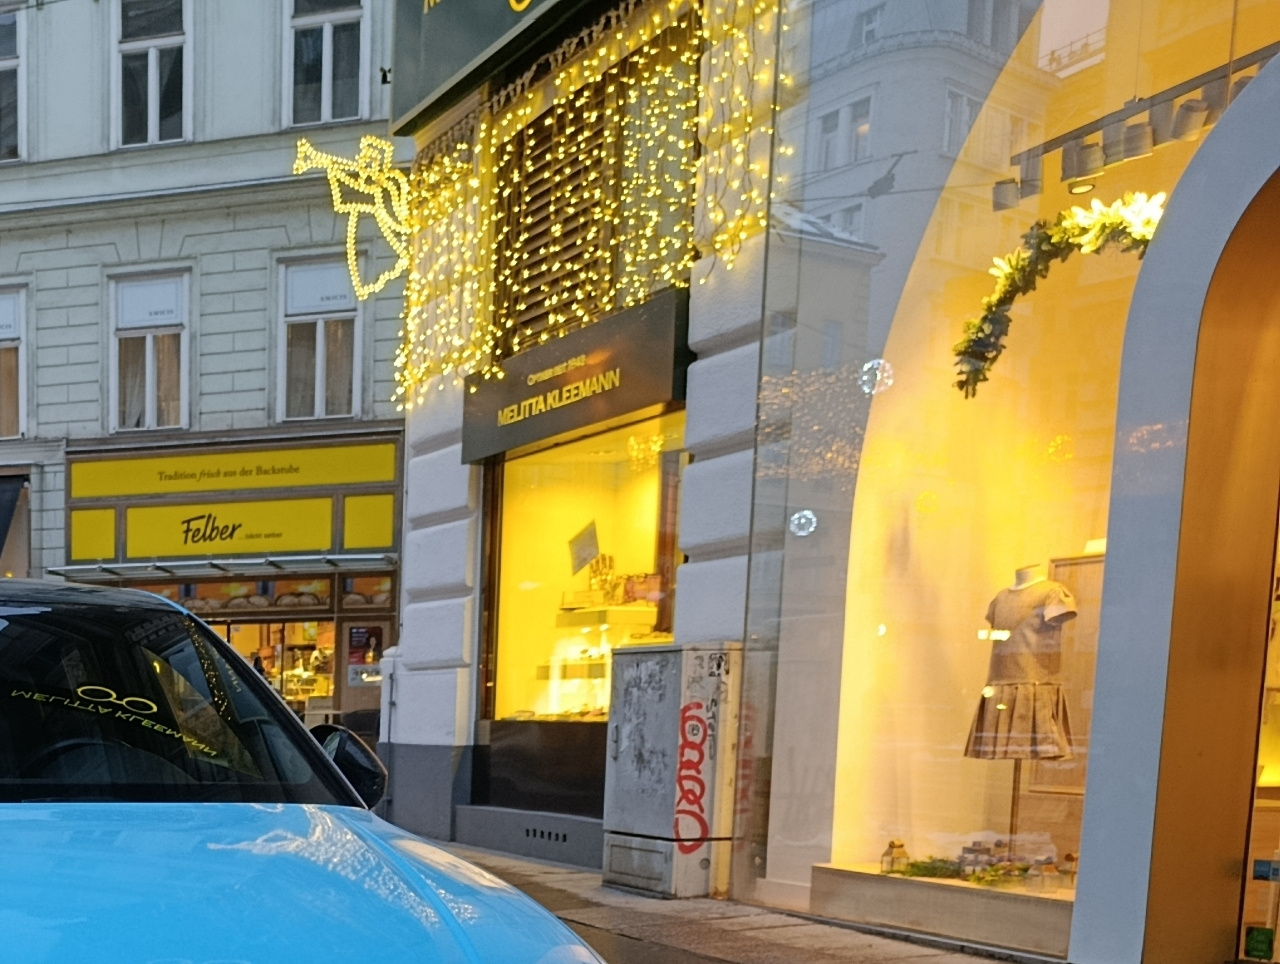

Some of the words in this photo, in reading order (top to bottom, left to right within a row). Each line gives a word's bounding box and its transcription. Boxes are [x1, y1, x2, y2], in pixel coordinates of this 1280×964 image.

[497, 395, 546, 427] MELITTA
[547, 367, 620, 411] KLEEMANN
[158, 471, 197, 482] Tradition
[198, 469, 222, 482] frisch
[223, 469, 237, 478] aus
[239, 467, 253, 477] der
[256, 464, 300, 476] Backstube
[181, 512, 242, 545] Felber
